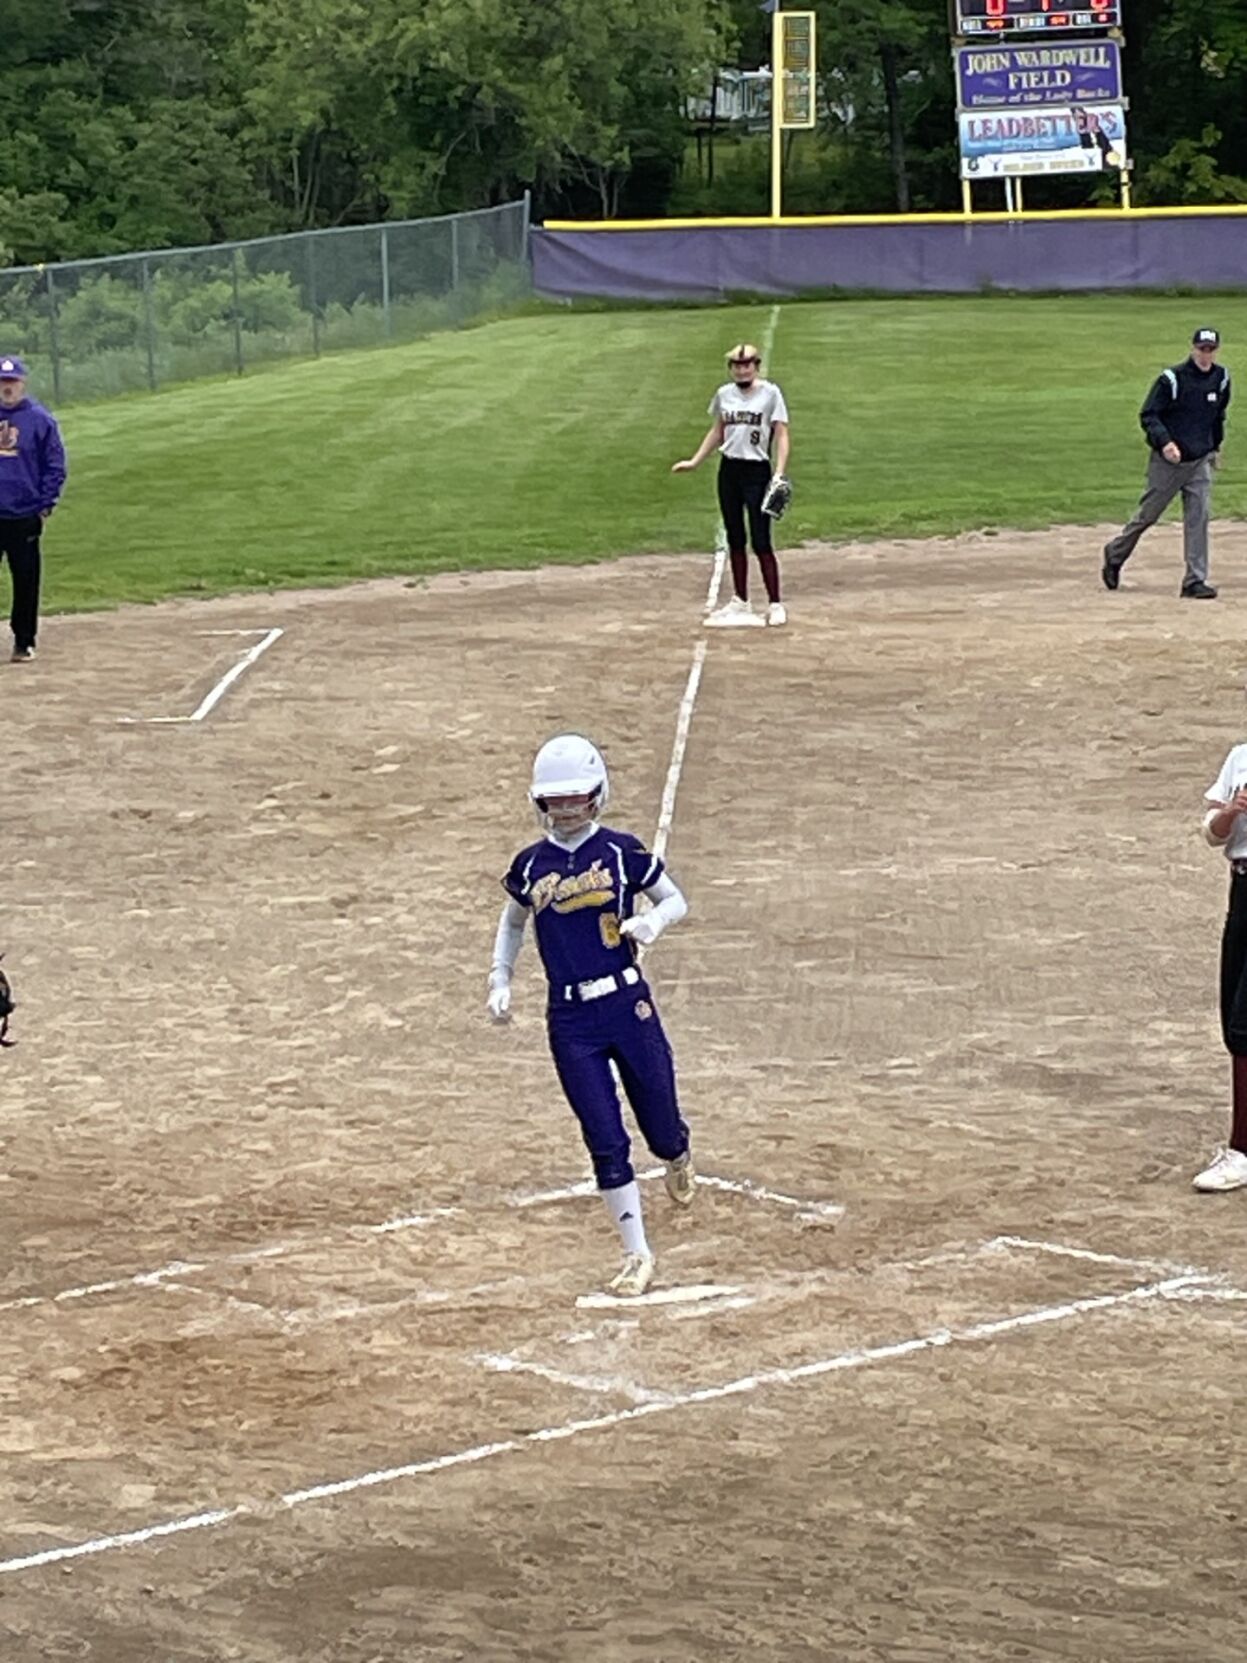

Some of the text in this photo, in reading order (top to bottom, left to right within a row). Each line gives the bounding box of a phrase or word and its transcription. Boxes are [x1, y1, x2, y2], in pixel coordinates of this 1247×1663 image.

[966, 47, 1110, 76] JOHN WARDWELL
[1008, 70, 1071, 90] FIELD
[968, 111, 1117, 142] LEADBETTER'S
